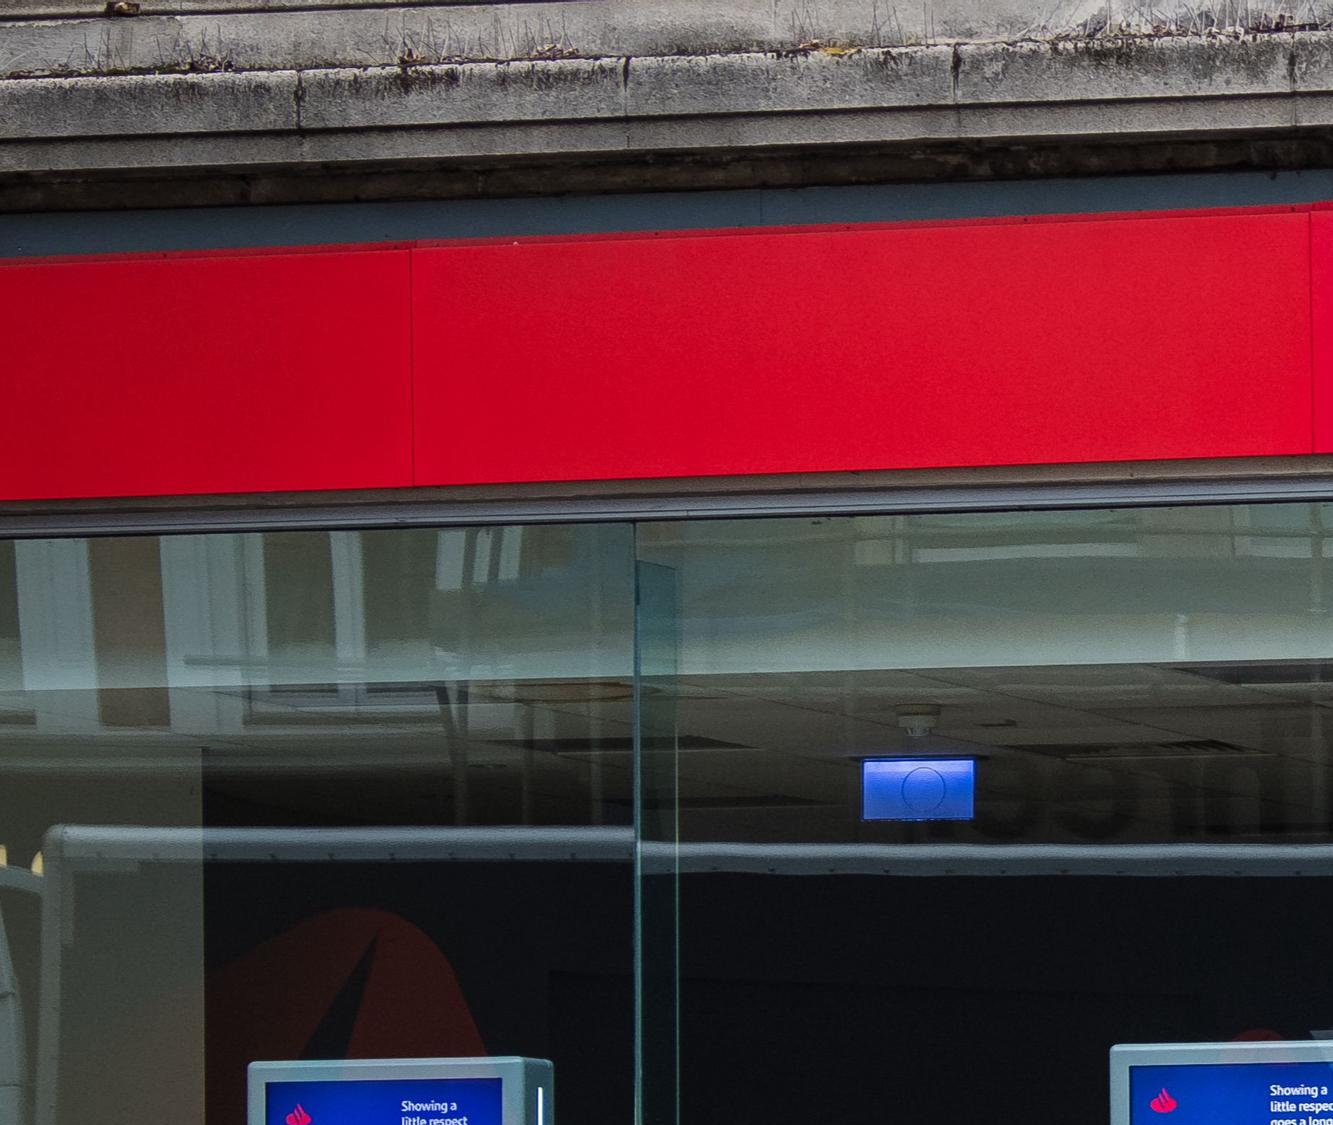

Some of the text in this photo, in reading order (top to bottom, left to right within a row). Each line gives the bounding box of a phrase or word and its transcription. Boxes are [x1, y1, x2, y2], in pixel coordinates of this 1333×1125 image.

[1270, 1084, 1328, 1098] Showing a
[401, 1100, 457, 1113] Showing a
[1270, 1101, 1296, 1112] little
